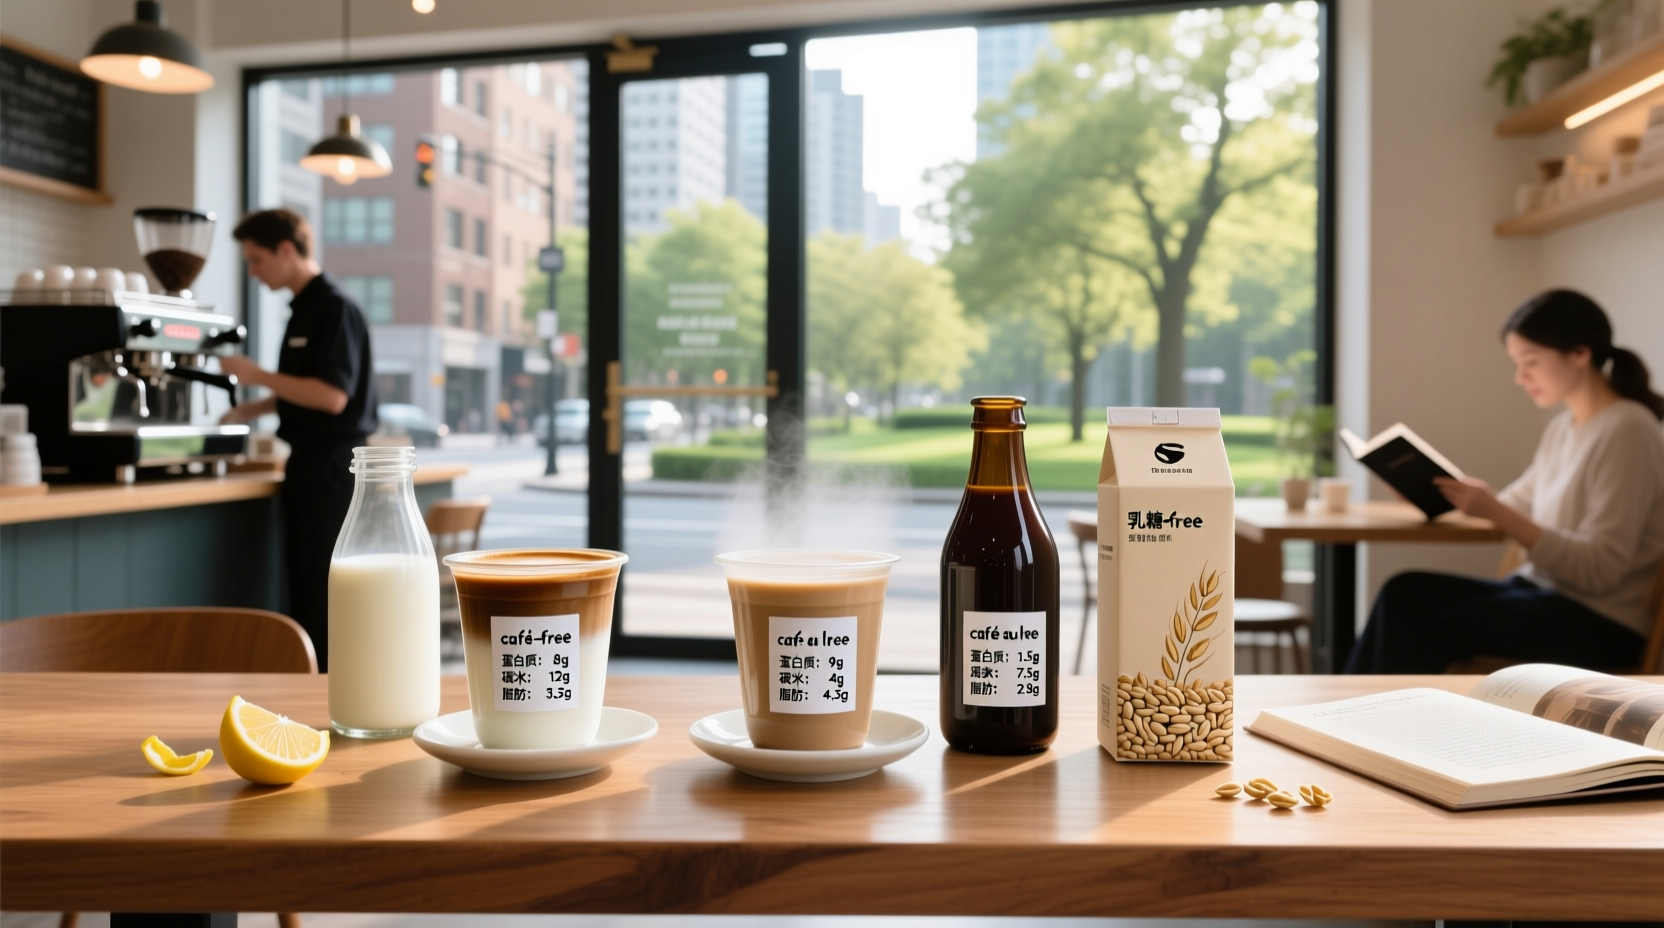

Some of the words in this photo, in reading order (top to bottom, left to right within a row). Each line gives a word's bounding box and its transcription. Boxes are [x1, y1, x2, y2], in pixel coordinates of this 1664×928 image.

[500, 629, 572, 645] café-free
[970, 625, 1000, 640] café
[553, 654, 569, 668] 8g
[828, 656, 844, 670] 9g
[549, 671, 570, 684] 12g
[828, 673, 844, 688] 4g
[1016, 667, 1040, 681] 7.5g
